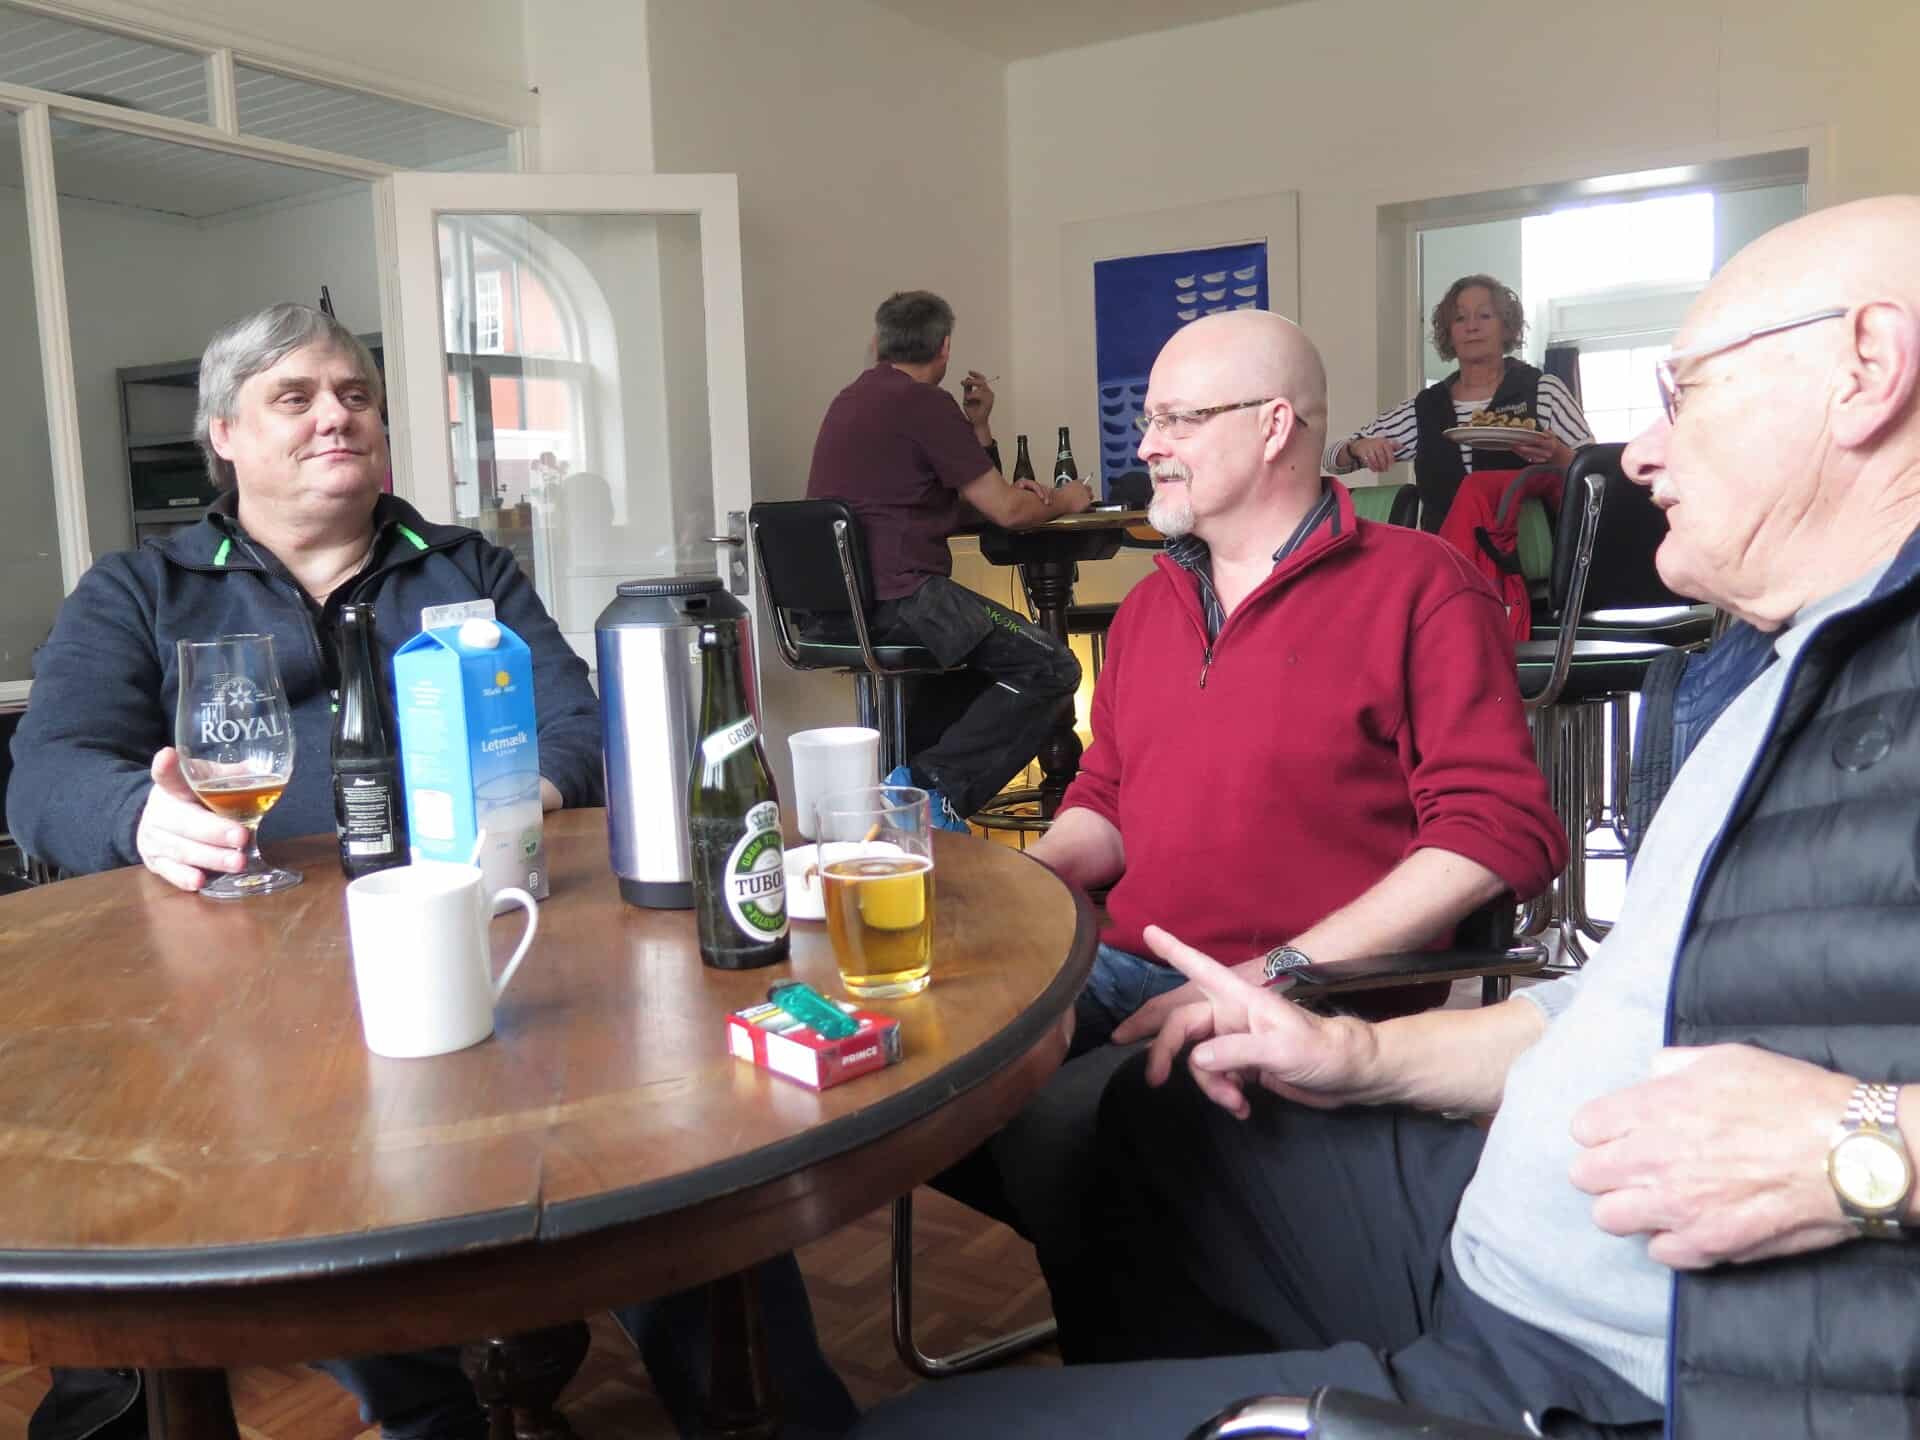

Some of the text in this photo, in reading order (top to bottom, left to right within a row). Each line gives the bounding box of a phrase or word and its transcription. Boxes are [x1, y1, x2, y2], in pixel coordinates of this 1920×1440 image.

[201, 714, 284, 743] ROYAL
[727, 719, 756, 746] GRØN
[481, 732, 528, 752] Letmælk
[736, 871, 785, 896] TUBO
[842, 1046, 878, 1065] PRINCE
